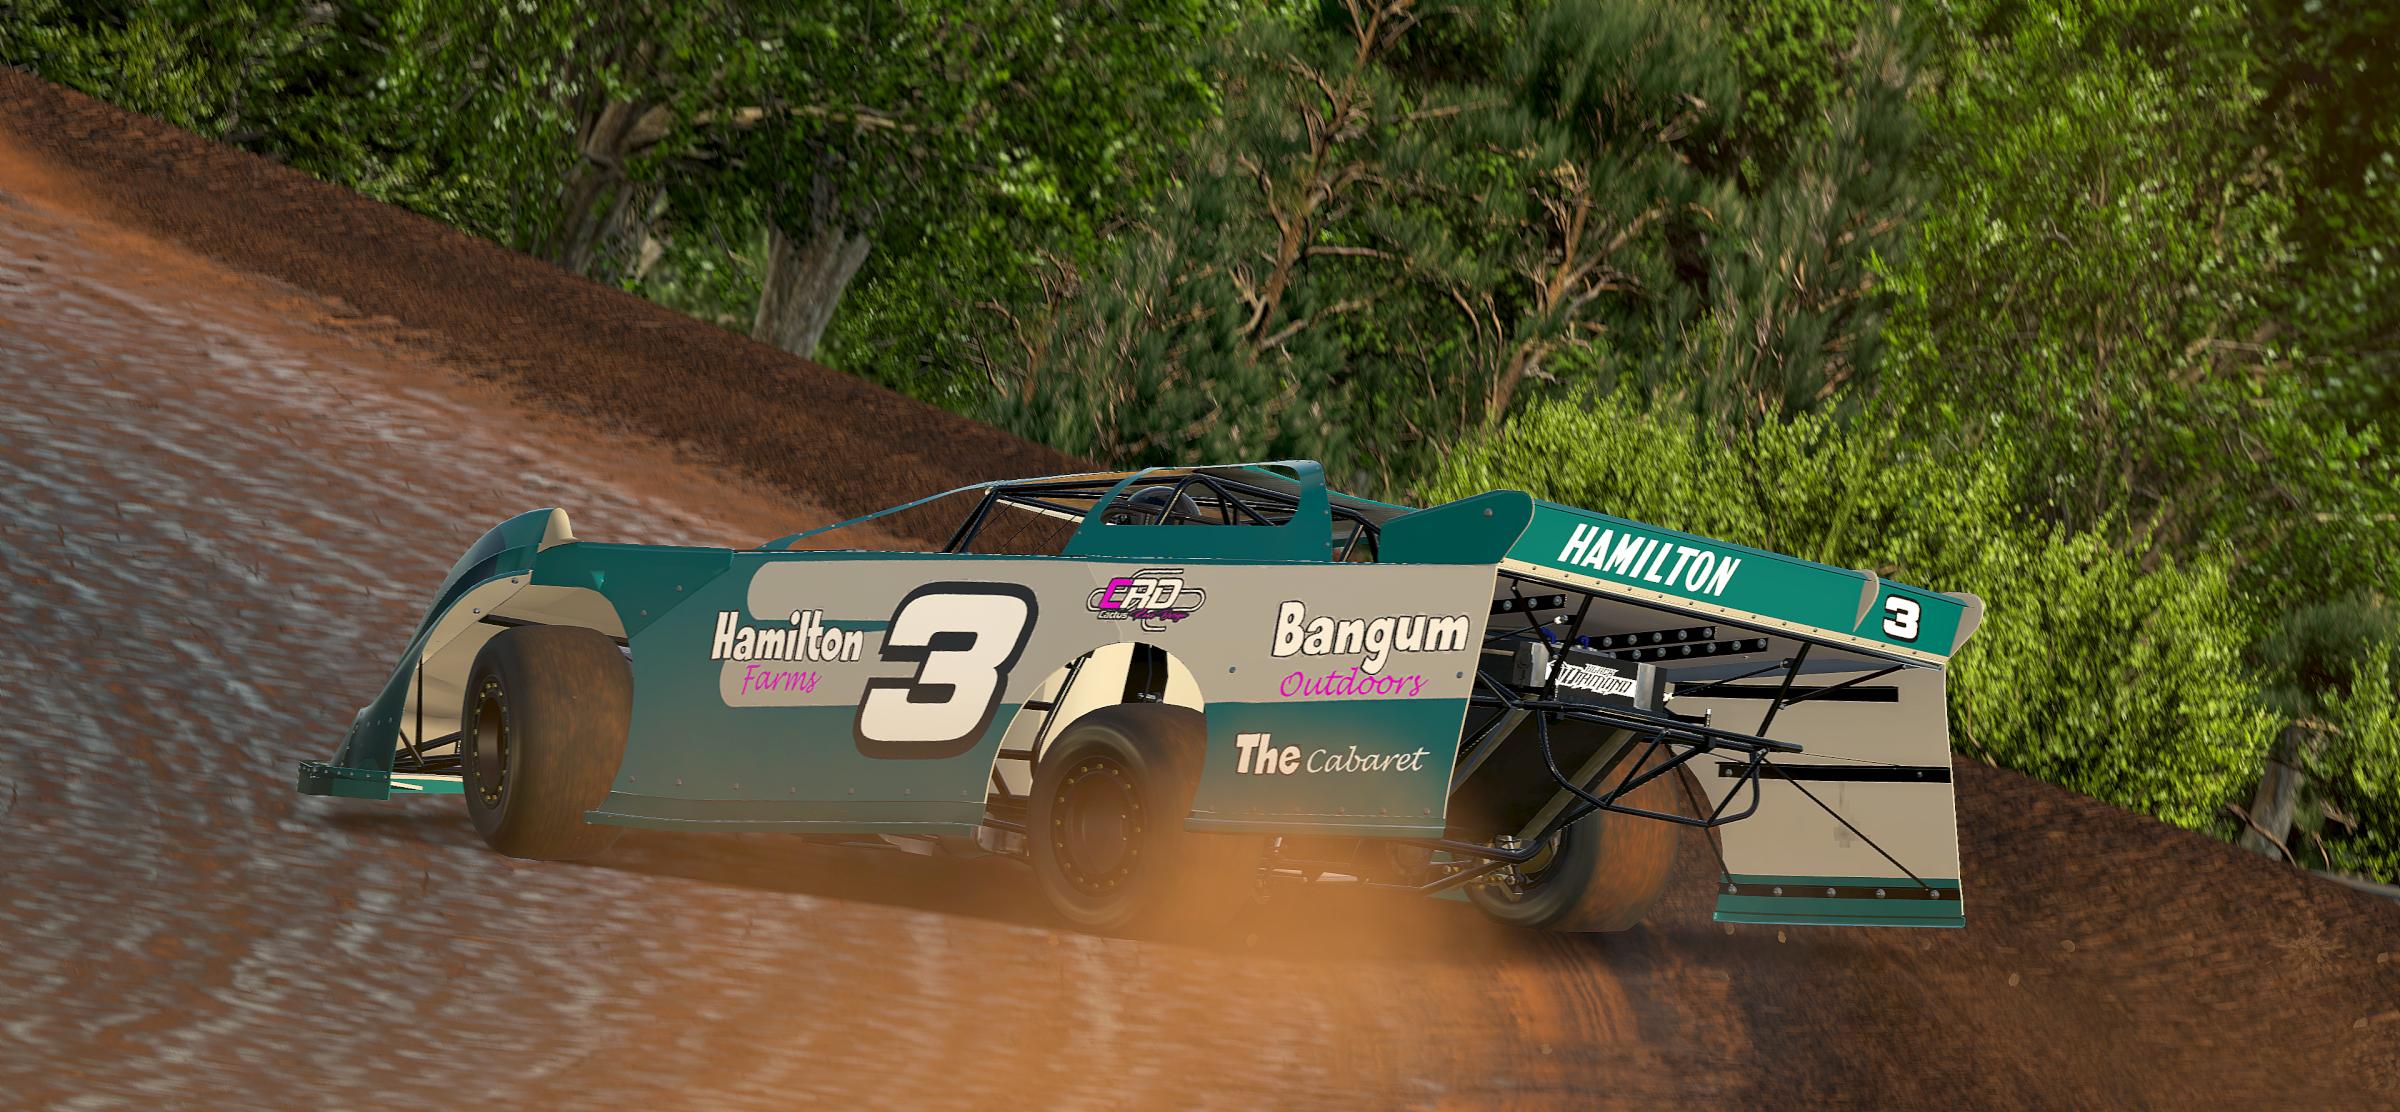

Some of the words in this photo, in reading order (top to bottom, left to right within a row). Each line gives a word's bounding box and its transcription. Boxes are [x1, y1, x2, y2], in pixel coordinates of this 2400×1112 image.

[1557, 523, 1742, 597] HAMILTON
[1097, 609, 1129, 620] Cactus
[1099, 577, 1184, 609] CRD
[709, 608, 864, 663] Hamilton
[1271, 600, 1470, 675] Bangum
[1881, 595, 1921, 642] 3
[740, 664, 823, 695] Farms
[853, 580, 1038, 759] 3
[1276, 667, 1429, 697] Outdoors
[1235, 732, 1301, 775] The
[1305, 745, 1430, 773] Cabaret
